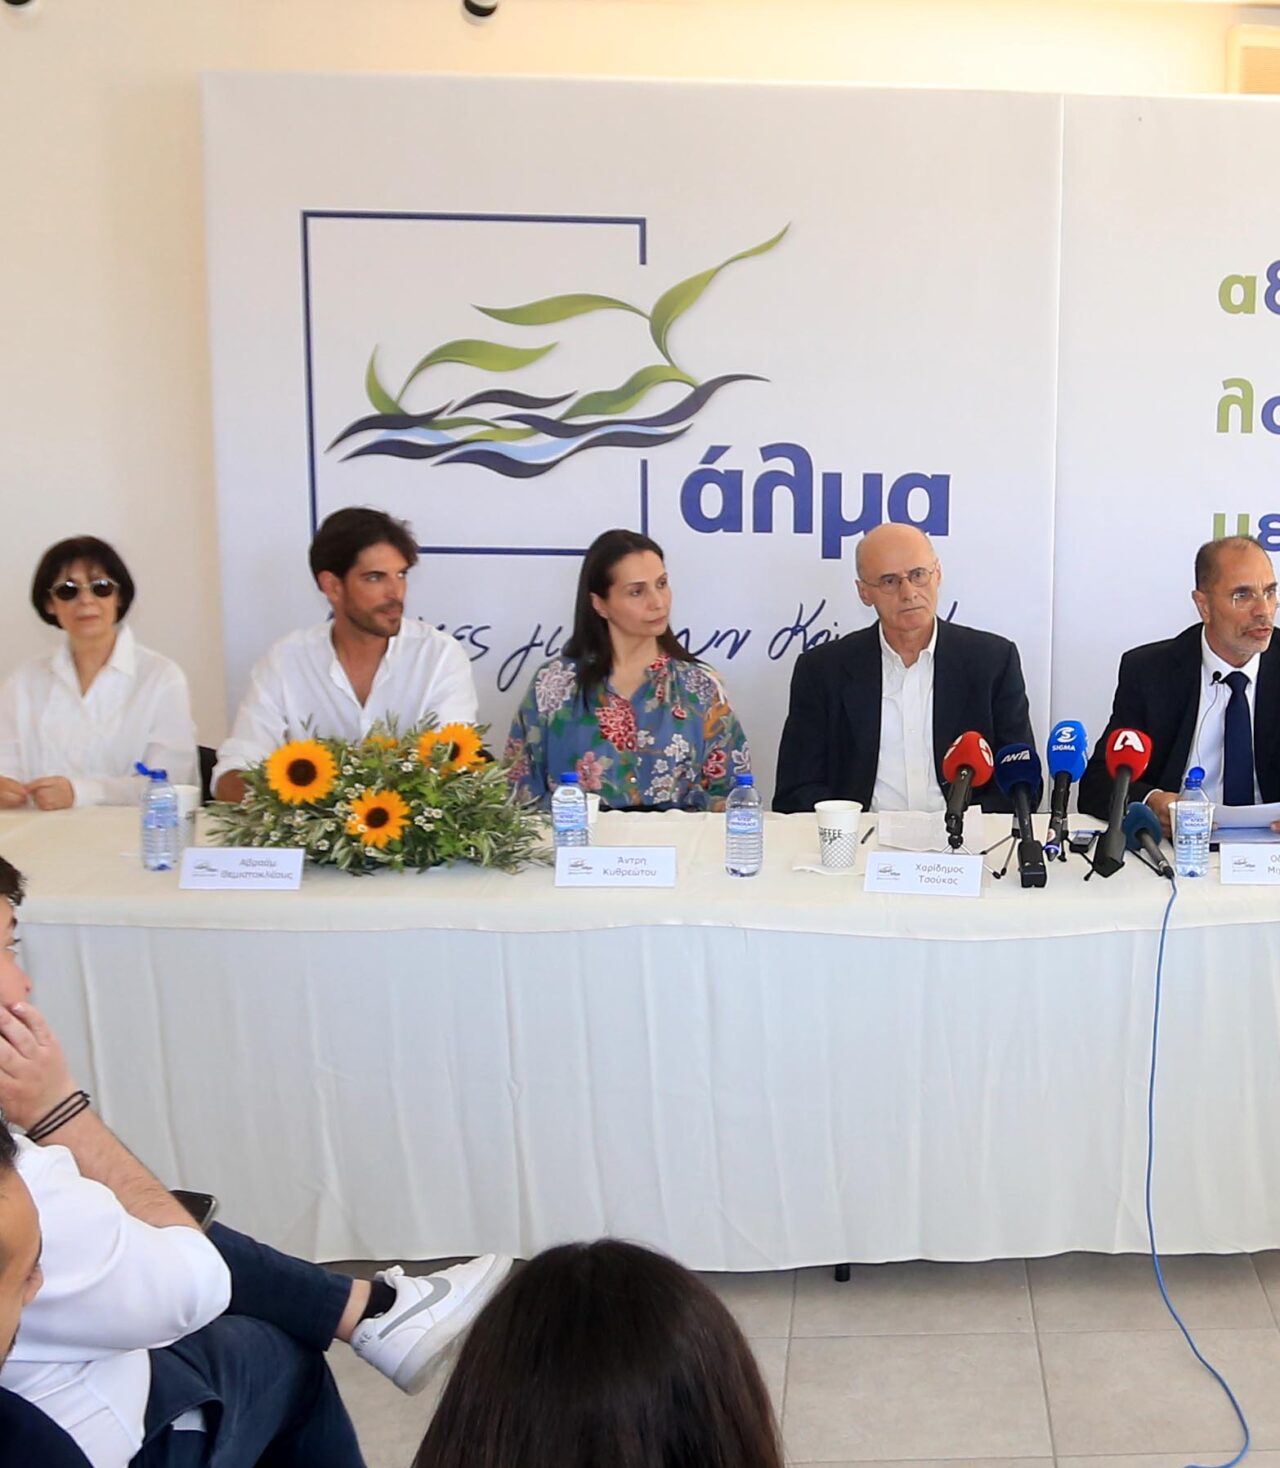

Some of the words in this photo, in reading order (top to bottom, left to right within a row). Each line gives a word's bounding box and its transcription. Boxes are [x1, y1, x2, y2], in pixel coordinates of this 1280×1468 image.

[679, 442, 952, 560] άλμα
[1051, 744, 1076, 752] SIGMA
[915, 863, 964, 874] Χαρίδημος
